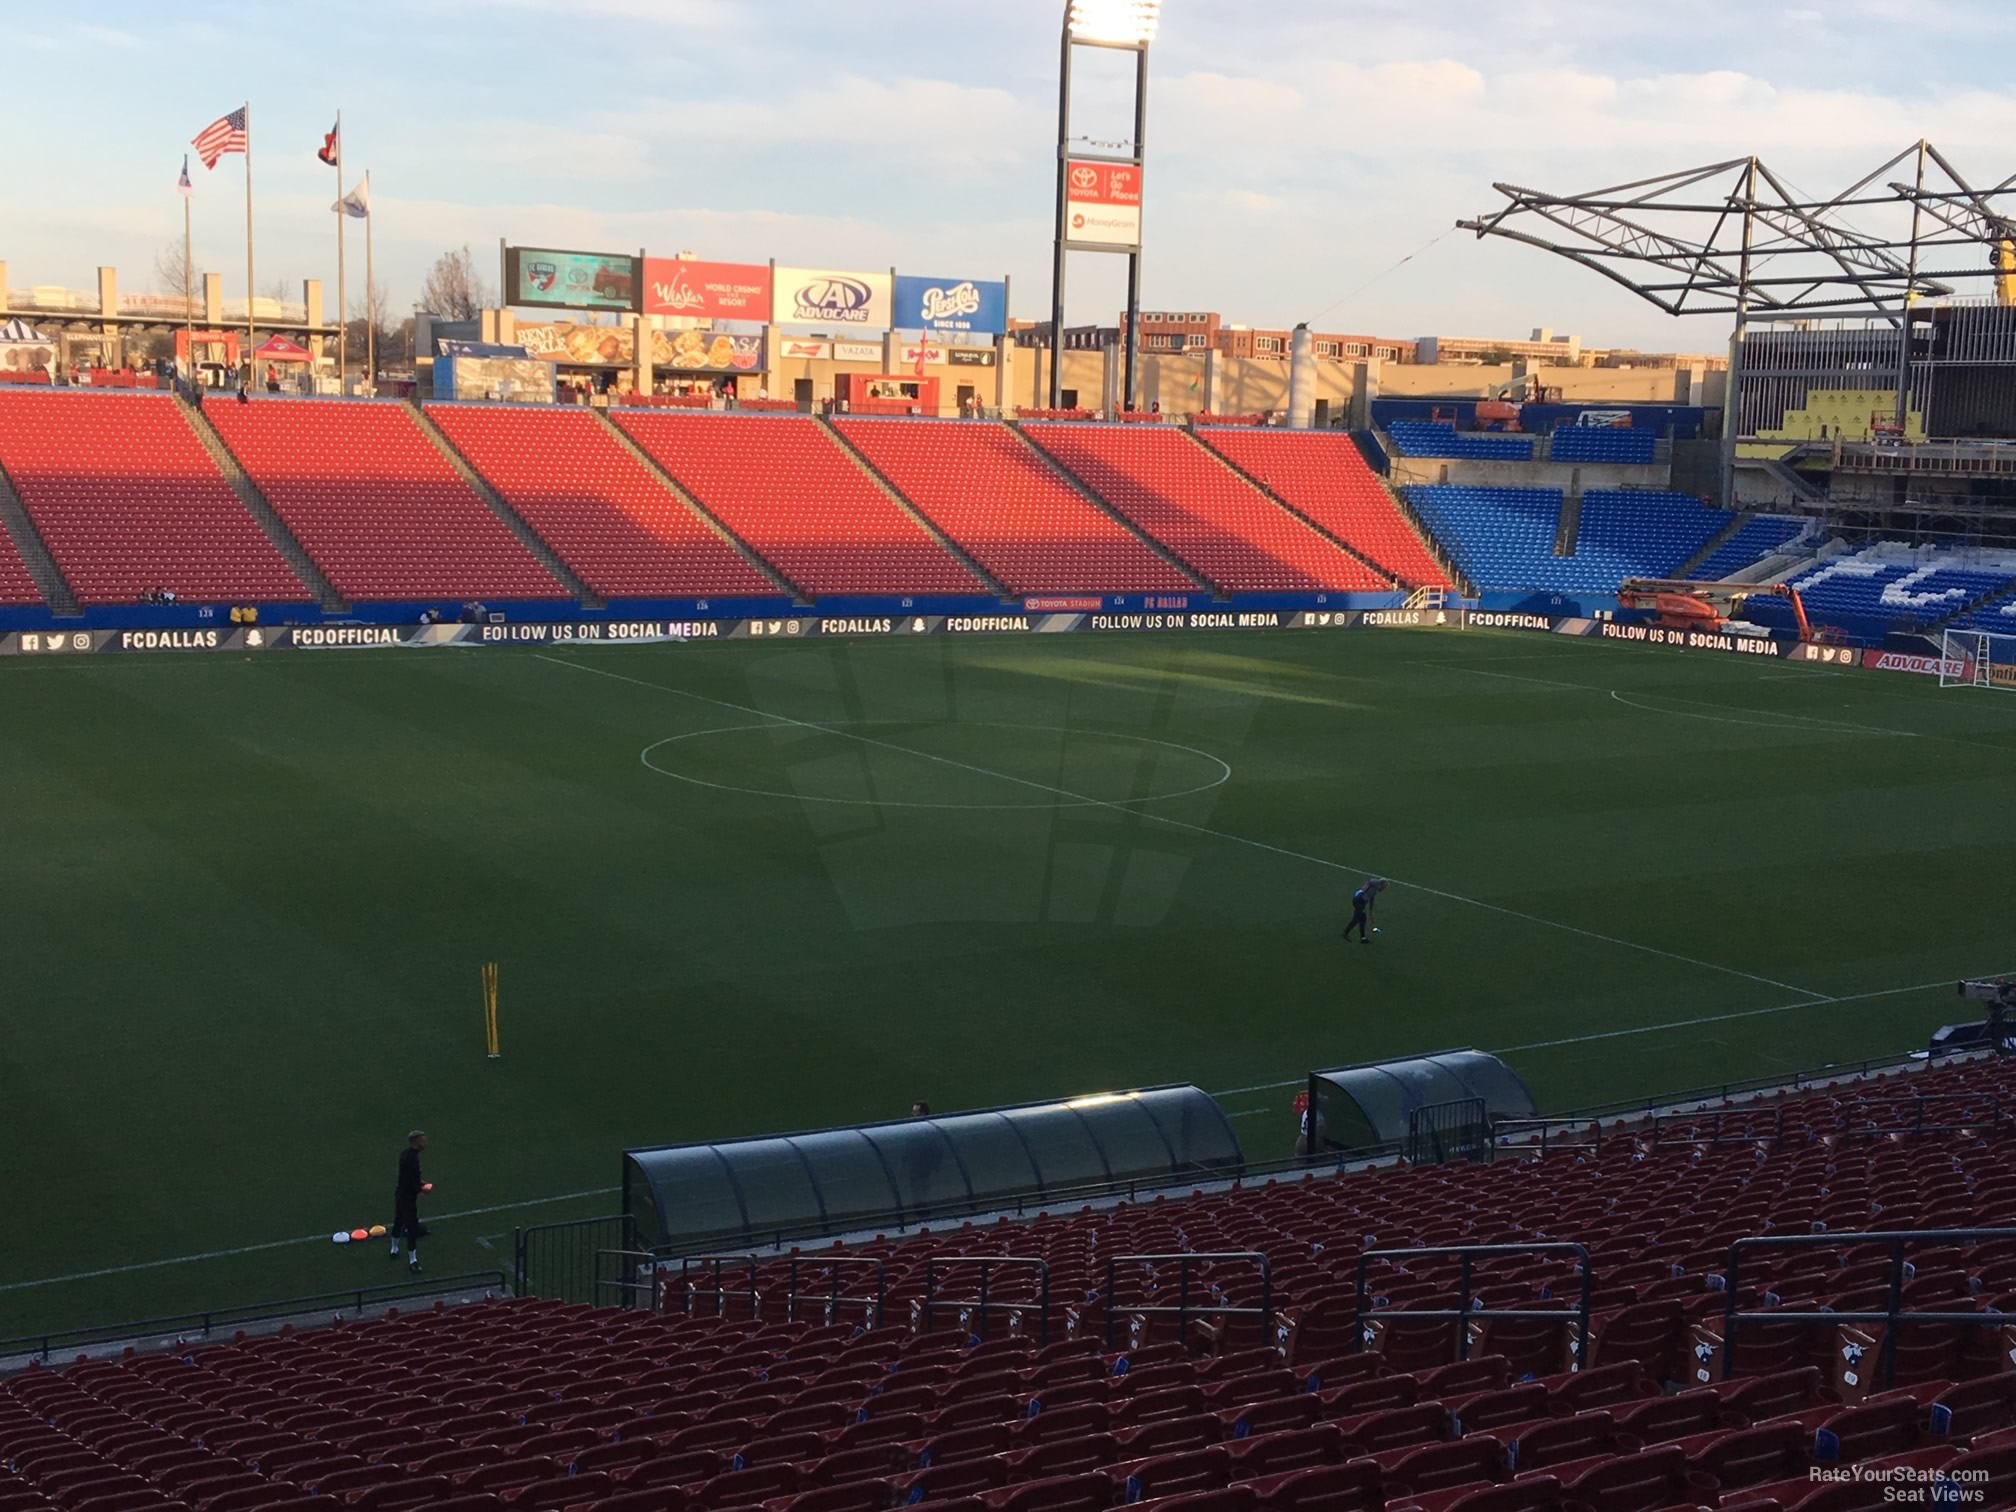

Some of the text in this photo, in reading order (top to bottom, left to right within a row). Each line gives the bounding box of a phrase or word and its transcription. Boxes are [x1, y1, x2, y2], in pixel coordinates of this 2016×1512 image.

[1111, 171, 1131, 181] Let's
[1068, 188, 1099, 198] TOYOTA
[1110, 181, 1123, 190] Go
[1110, 190, 1139, 201] Places
[1087, 217, 1135, 229] MoneyGram
[652, 272, 704, 309] WinStar
[704, 283, 761, 294] WORLD CASINO
[718, 297, 747, 307] RESORT
[793, 305, 869, 322] ADVOCARE
[934, 320, 954, 328] SINCE
[516, 327, 554, 344] BENT
[841, 346, 874, 355] VAZATA
[821, 618, 891, 634] FCDALLAS
[947, 617, 1029, 631] FCDOFFICIAL
[1092, 613, 1279, 630] FOLLOW US ON SOCIAL MEDIA
[1363, 612, 1420, 625] FCDALLAS
[1469, 612, 1550, 630] FCDOFFICIAL
[292, 628, 401, 645] FCDOFFICIAL
[552, 625, 573, 640] US
[578, 624, 600, 640] ON
[608, 623, 664, 638] SOCIAL
[669, 621, 718, 637] MEDIA
[122, 631, 217, 649] FCDALLAS
[1602, 623, 1778, 656] FOLLOW US ON SOCIAL MEDIA
[1877, 653, 1966, 676] ADVOCARE
